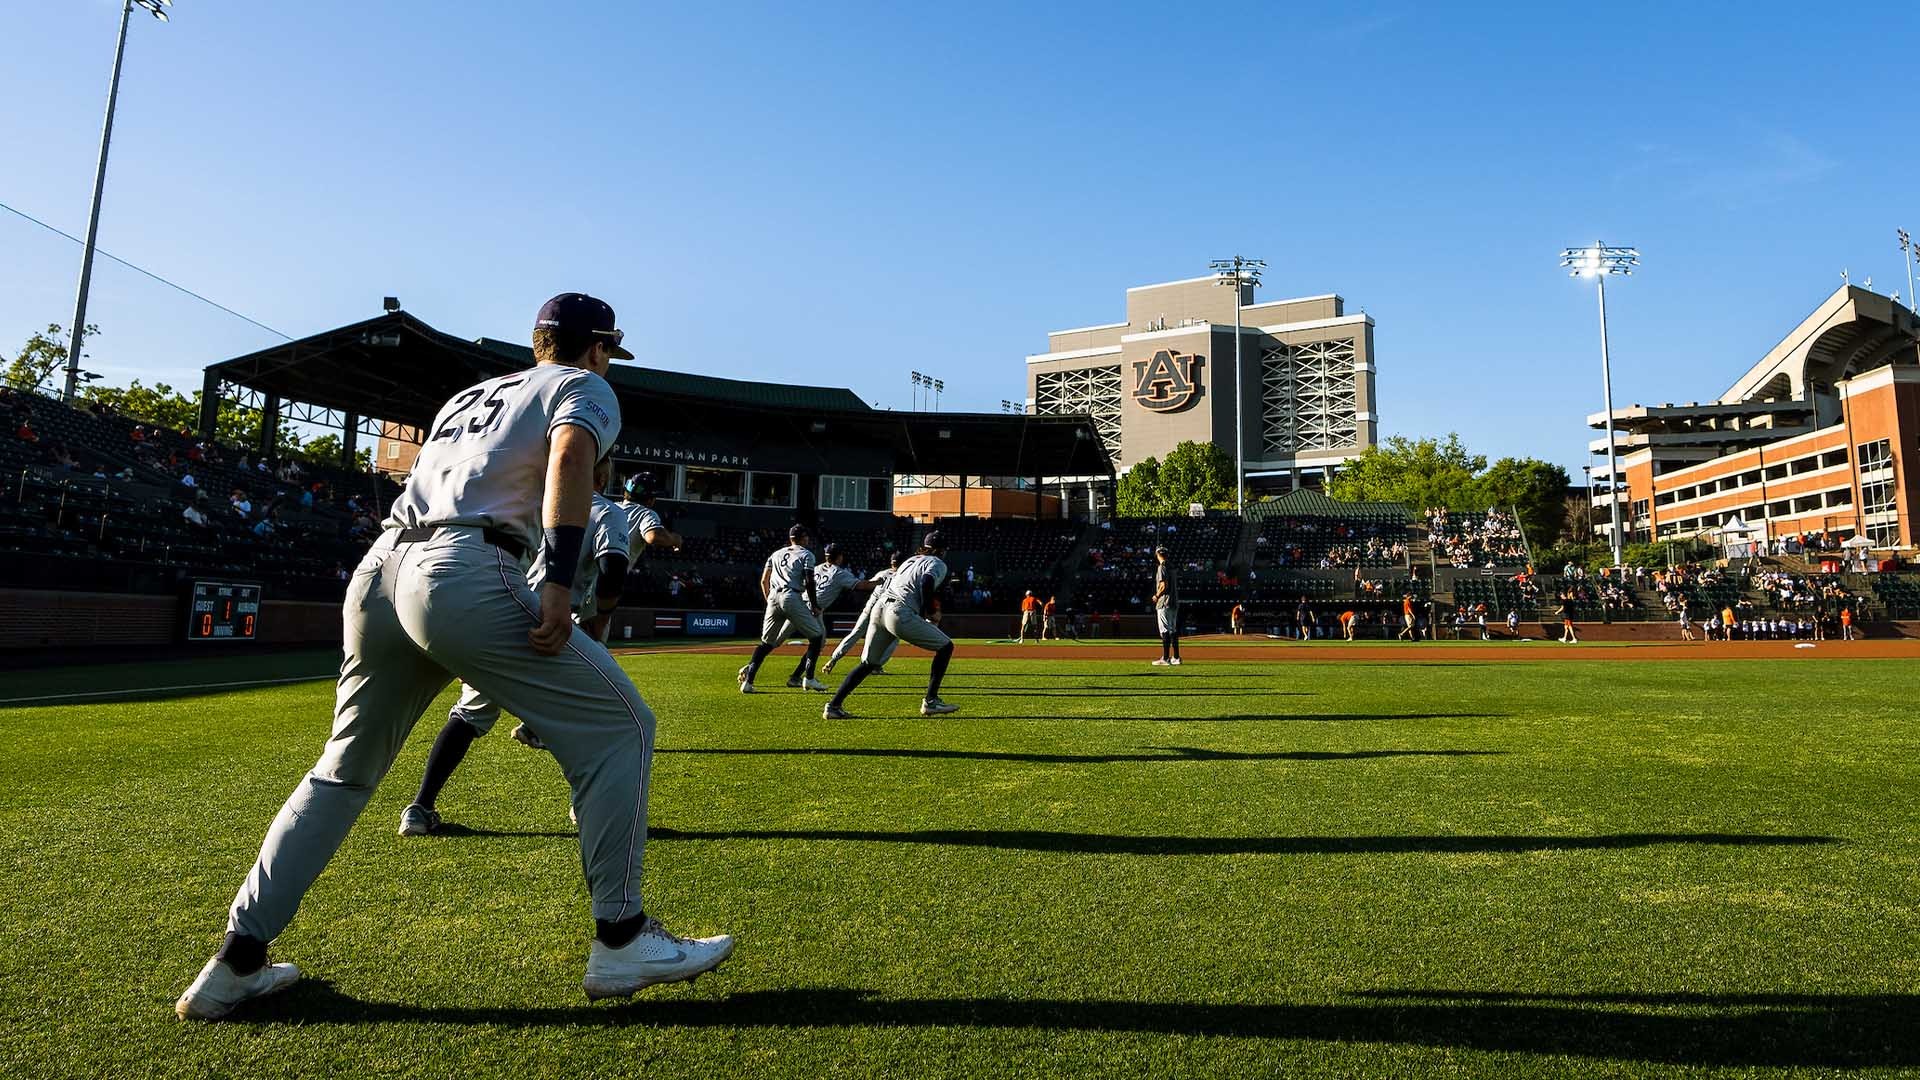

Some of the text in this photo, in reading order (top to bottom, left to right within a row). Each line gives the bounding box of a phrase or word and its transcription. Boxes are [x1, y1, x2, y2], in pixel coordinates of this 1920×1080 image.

[431, 378, 530, 442] 25
[613, 444, 749, 465] PLAINSMAN PARK
[780, 553, 790, 567] 8
[202, 614, 212, 636] 0
[244, 615, 254, 635] 0
[692, 618, 729, 627] AUBURN
